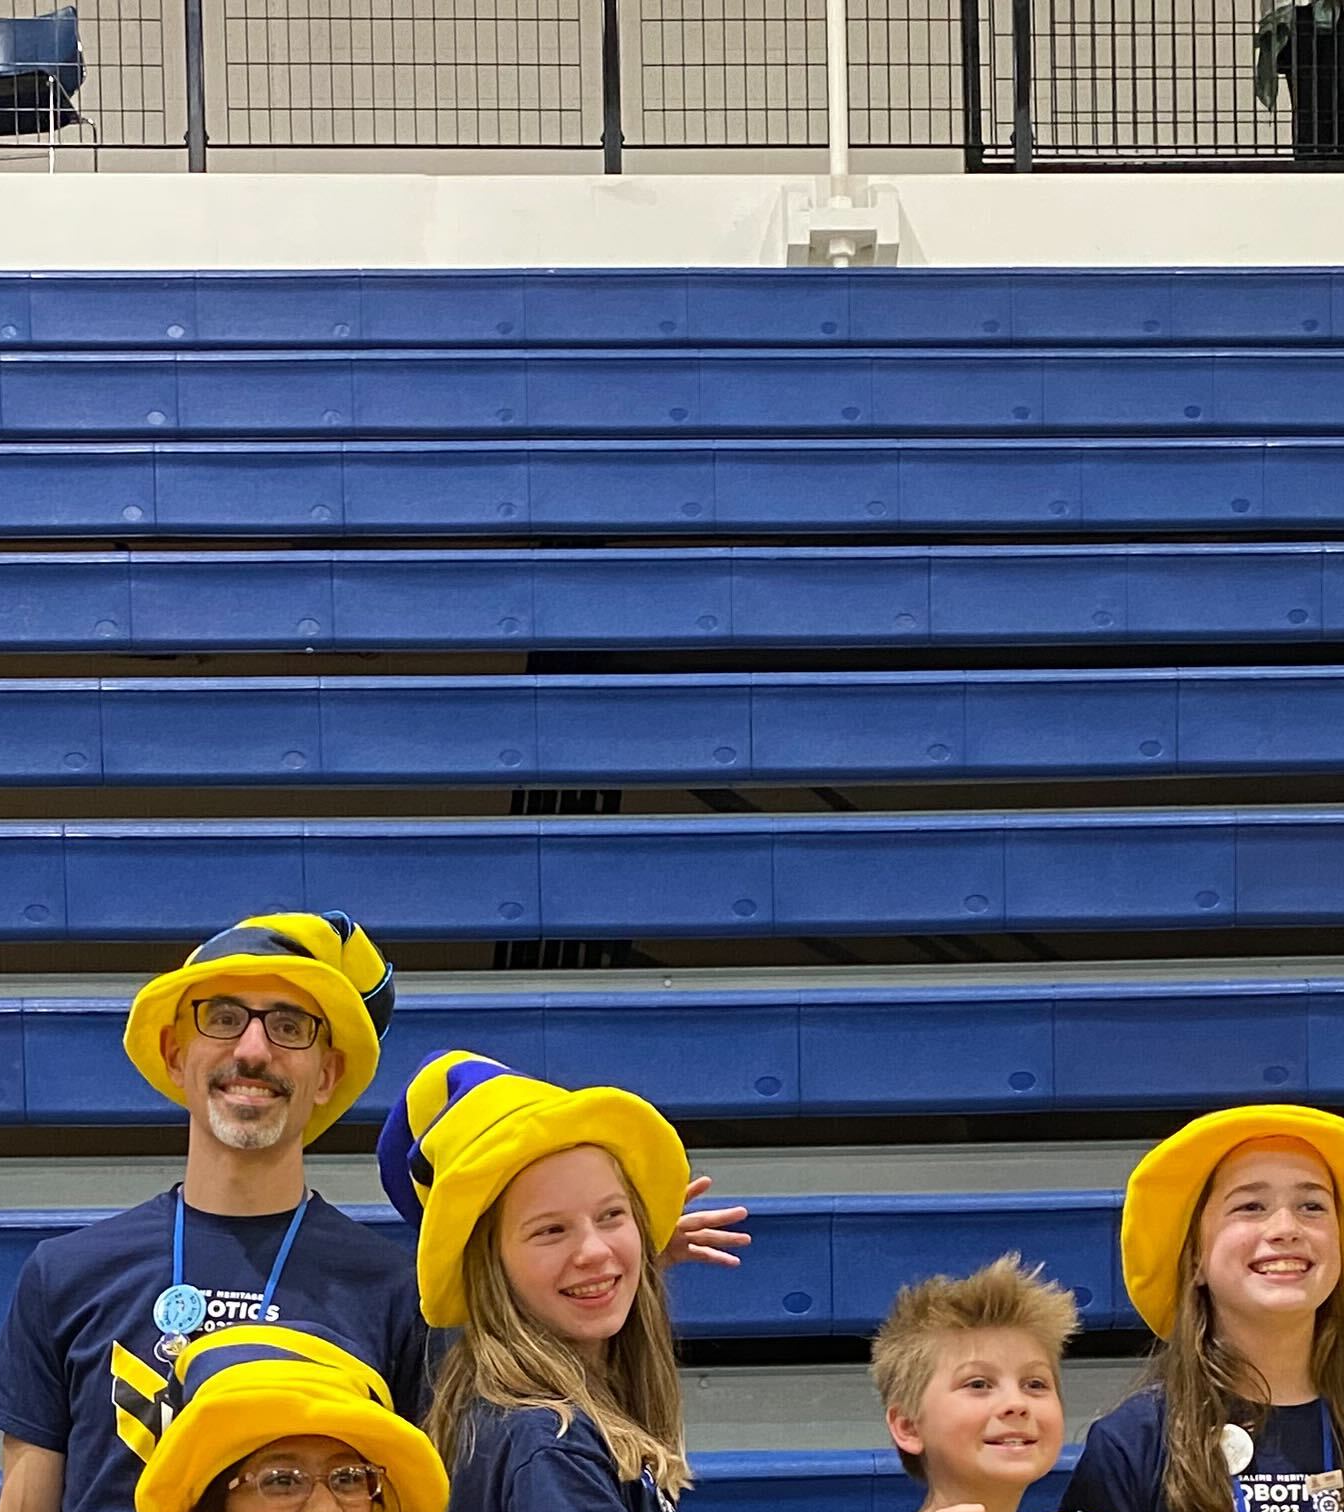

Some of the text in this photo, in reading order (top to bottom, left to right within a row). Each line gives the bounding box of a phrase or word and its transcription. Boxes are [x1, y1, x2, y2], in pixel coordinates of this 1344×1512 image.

[216, 1290, 264, 1301] HERITAGE
[207, 1300, 280, 1321] OTICS
[1239, 1474, 1309, 1482] ALINE HERIT
[1240, 1483, 1309, 1502] OBOTI
